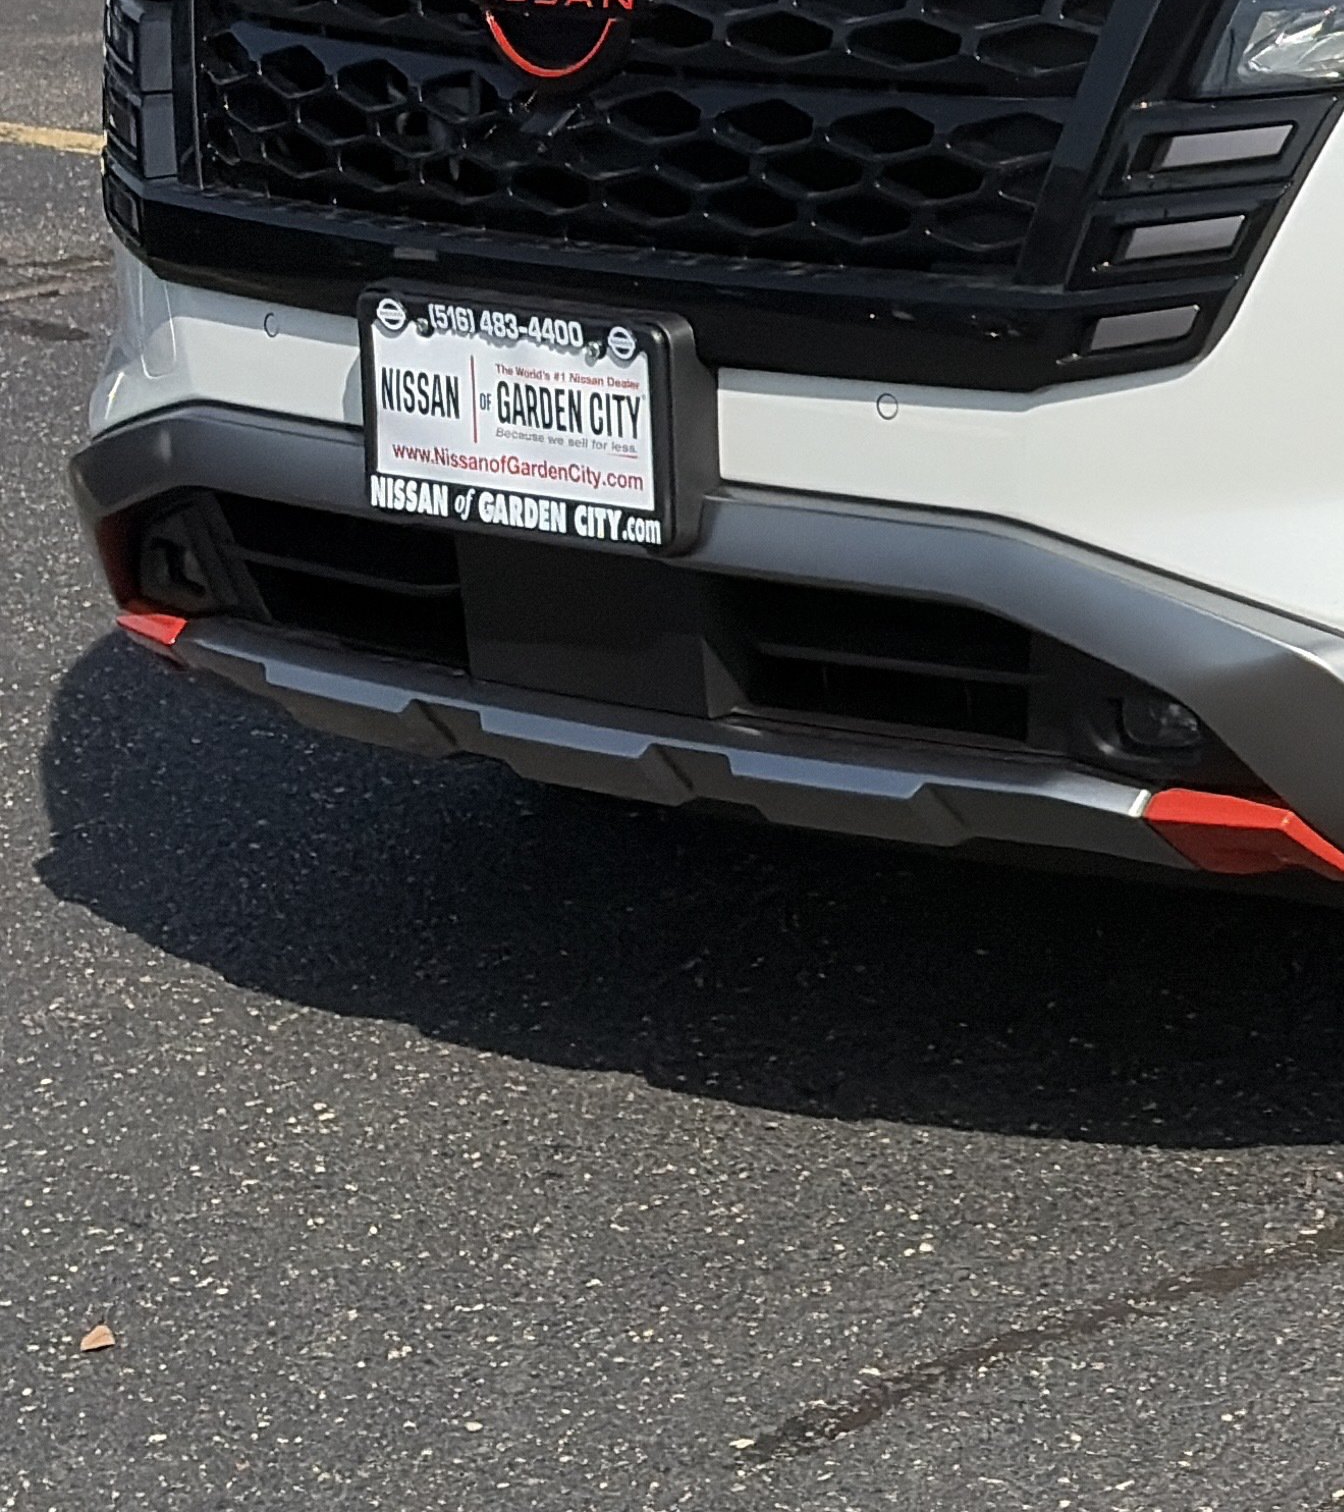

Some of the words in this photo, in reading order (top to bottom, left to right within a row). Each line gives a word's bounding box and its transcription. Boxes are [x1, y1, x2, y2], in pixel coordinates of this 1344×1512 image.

[428, 303, 475, 333] (516)
[479, 310, 584, 348] 483-4400
[496, 363, 513, 376] The
[516, 366, 551, 382] World's
[553, 371, 566, 383] #1
[569, 372, 604, 387] Nissan
[607, 376, 640, 390] Dealer
[381, 367, 461, 420] NISSAN
[480, 392, 492, 411] OF
[497, 381, 583, 435] GARDEN
[590, 391, 641, 439] CITY
[496, 427, 545, 444] Because
[548, 435, 564, 445] we
[568, 434, 589, 449] sell
[592, 435, 608, 451] for
[393, 443, 644, 491] www.NissanofGardenCity.com
[371, 475, 448, 517] NISSAN
[454, 488, 475, 521] of
[478, 491, 567, 534] GARDEN
[574, 505, 662, 544] CITY.com
